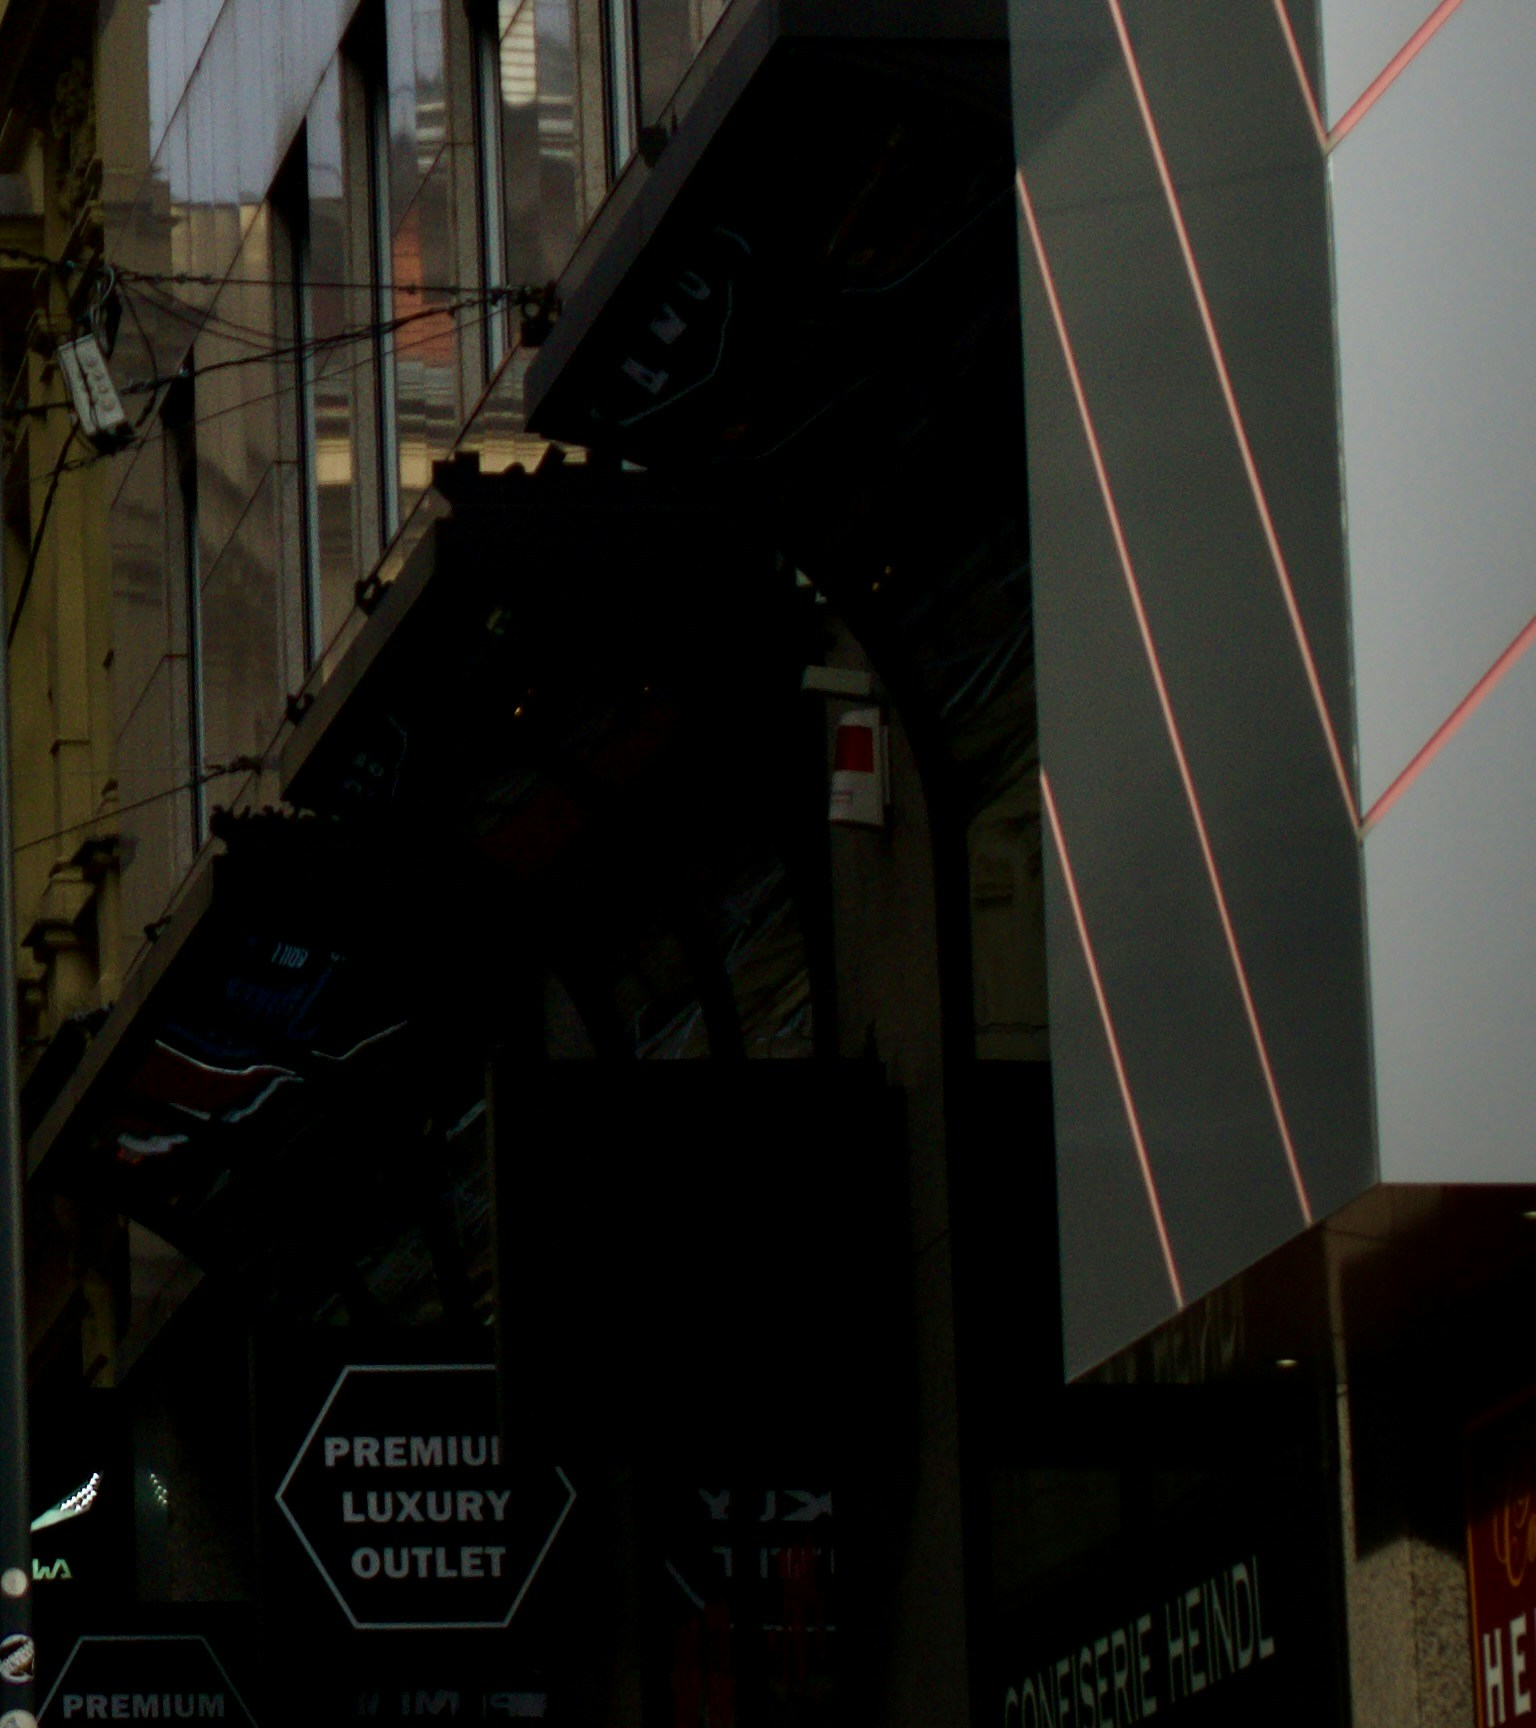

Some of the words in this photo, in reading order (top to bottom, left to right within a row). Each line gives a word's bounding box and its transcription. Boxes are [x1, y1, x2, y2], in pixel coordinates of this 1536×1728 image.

[324, 1435, 500, 1469] PREMIU
[342, 1489, 512, 1524] LUXURY
[351, 1545, 508, 1580] OUTLET
[1164, 1553, 1276, 1705] HEINDL
[1482, 1606, 1536, 1728] HE
[62, 1692, 226, 1721] PREMIUM
